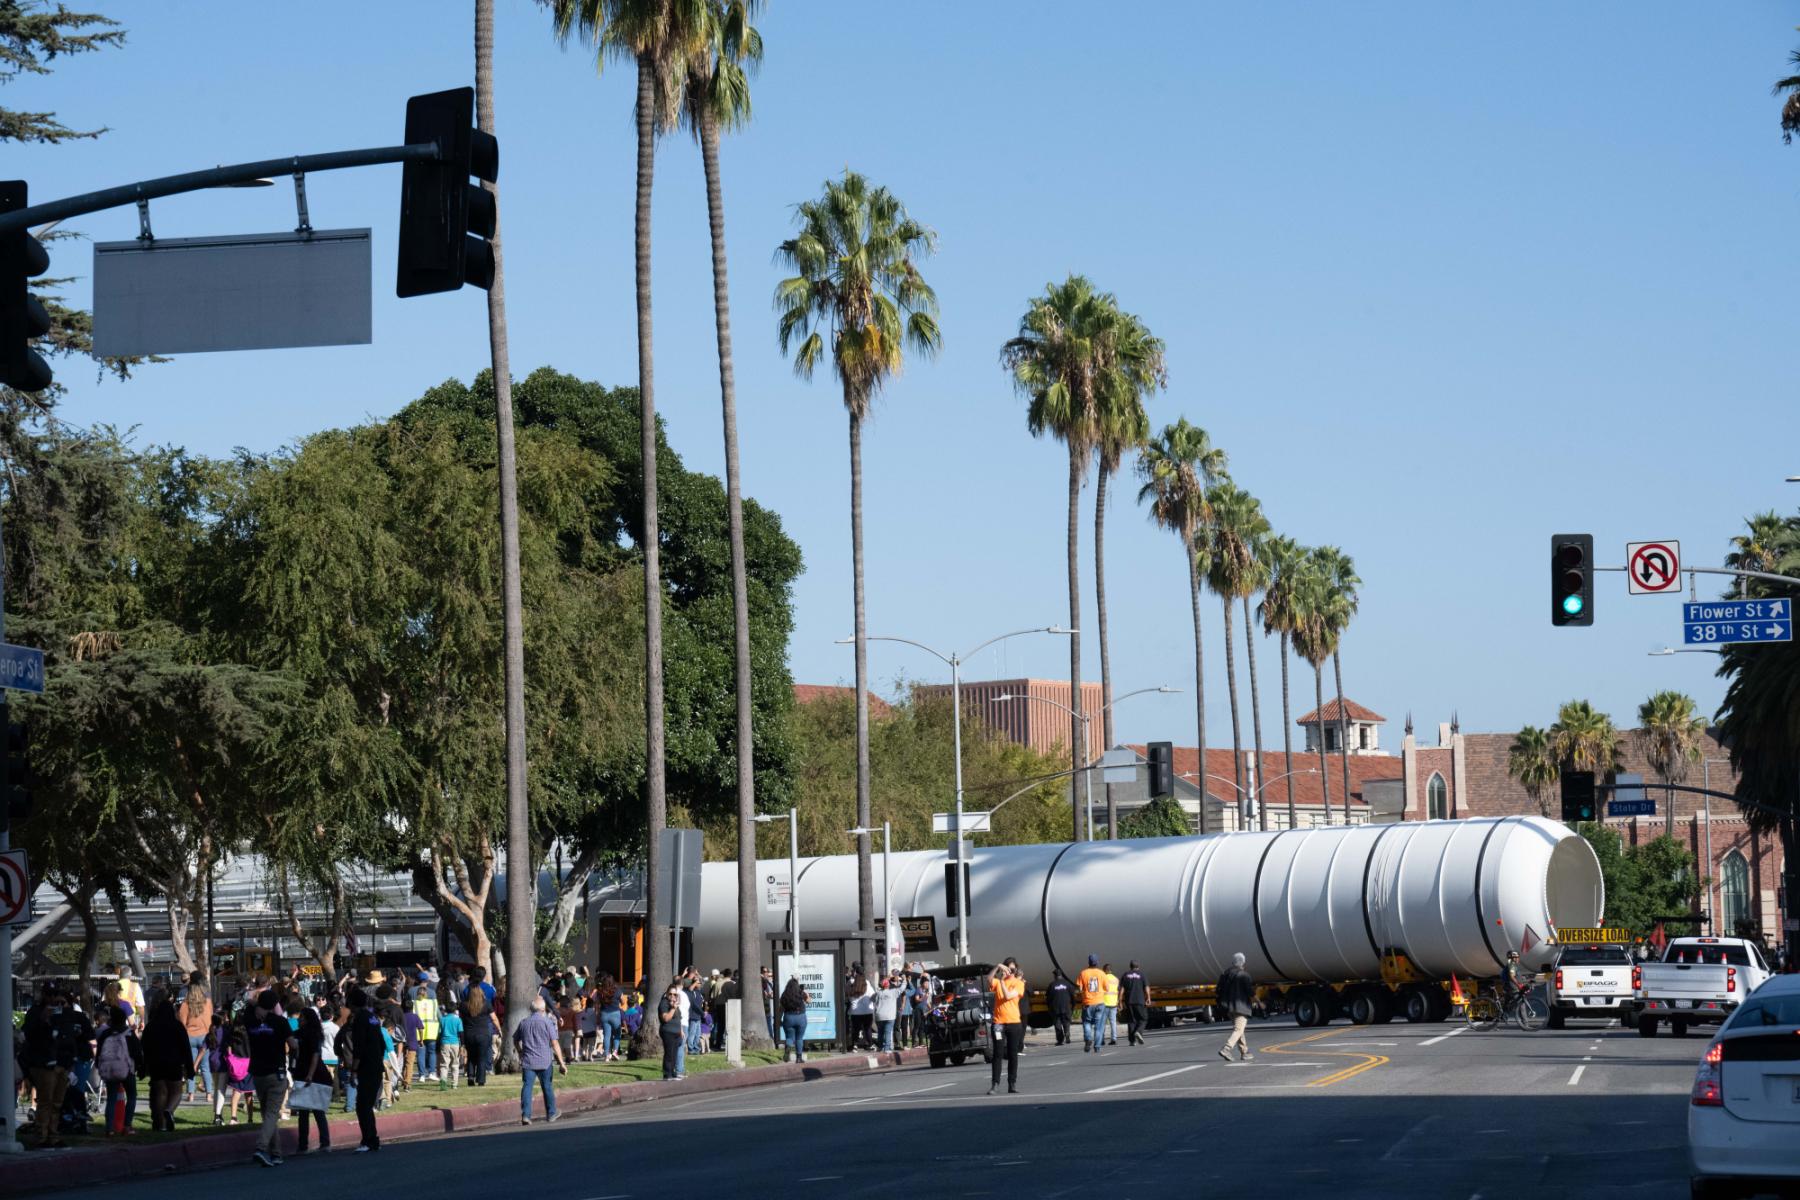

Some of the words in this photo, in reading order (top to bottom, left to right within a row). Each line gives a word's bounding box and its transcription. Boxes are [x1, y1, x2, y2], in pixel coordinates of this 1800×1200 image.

[1690, 604, 1740, 620] Flower
[1745, 603, 1762, 617] St
[1692, 625, 1717, 641] 38
[1721, 624, 1734, 635] th
[1741, 624, 1758, 639] St
[0, 659, 24, 678] eroa
[27, 658, 39, 680] St
[1612, 804, 1636, 812] State
[1640, 803, 1651, 811] Dr
[1558, 929, 1604, 942] OVERSIZE
[1606, 929, 1630, 941] LOAD
